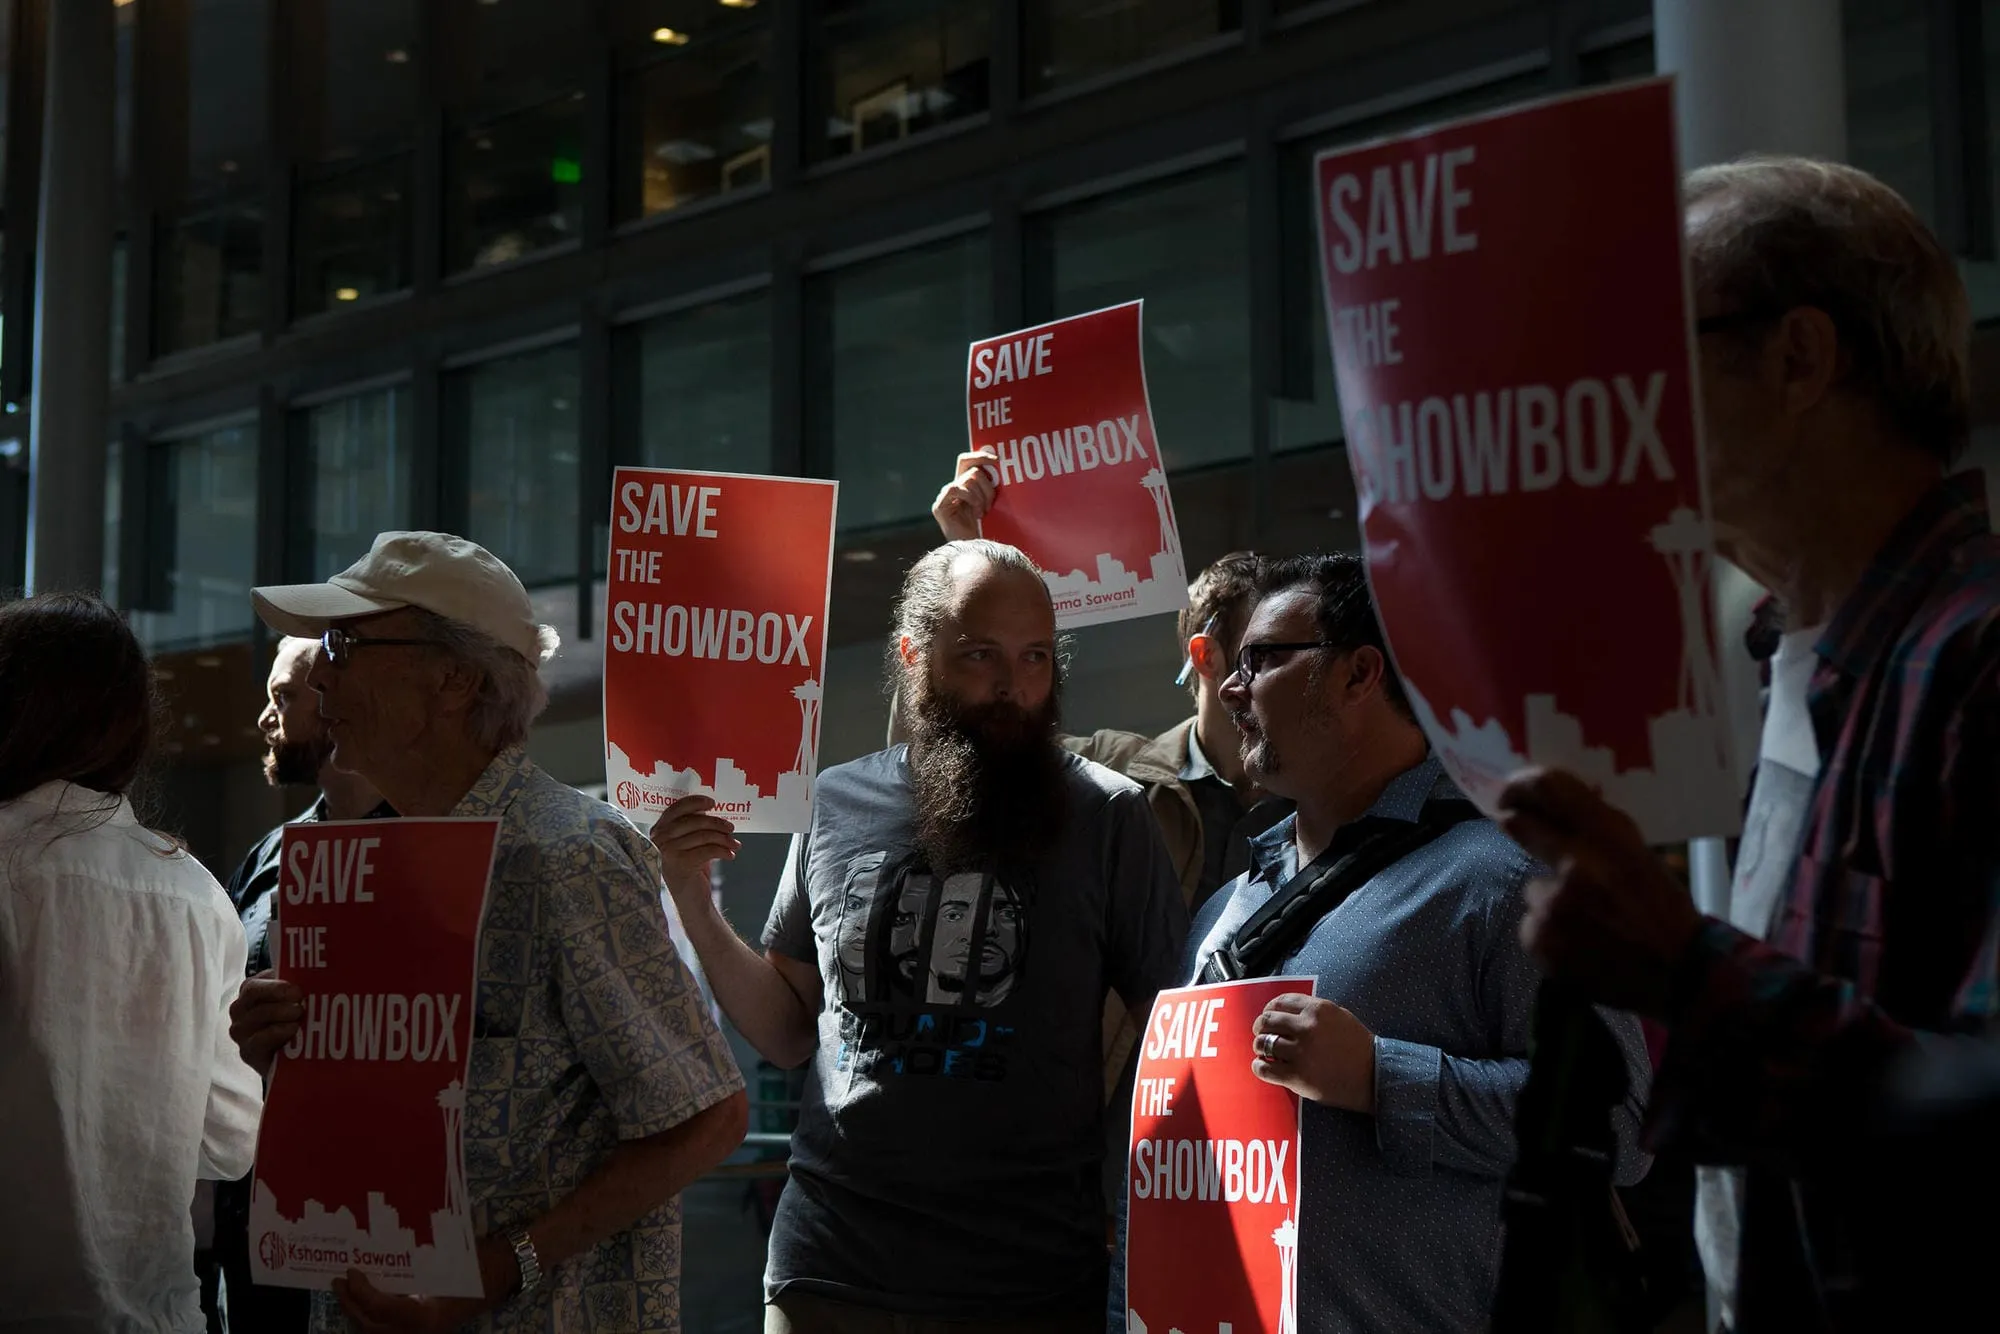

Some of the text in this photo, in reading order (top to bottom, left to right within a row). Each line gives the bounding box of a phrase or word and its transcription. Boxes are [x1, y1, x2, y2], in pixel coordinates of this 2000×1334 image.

[1329, 147, 1477, 276] SAVE
[974, 332, 1054, 389] SAVE
[1337, 298, 1403, 368] THE
[973, 396, 1012, 430] THE
[1354, 372, 1675, 502] SHOWBOX
[618, 481, 721, 538] SAVE
[616, 549, 663, 584] THE
[1052, 598, 1082, 611] ama
[1086, 587, 1136, 605] Sawant
[612, 601, 814, 668] SHOWBOX
[713, 800, 752, 813] want
[286, 839, 380, 903] SAVE
[286, 924, 328, 967] THE
[1147, 997, 1224, 1061] SAVE
[1140, 1077, 1175, 1116] THE
[1134, 1138, 1289, 1204] SHOWBOX
[288, 1243, 411, 1267] Kshama Sawant
